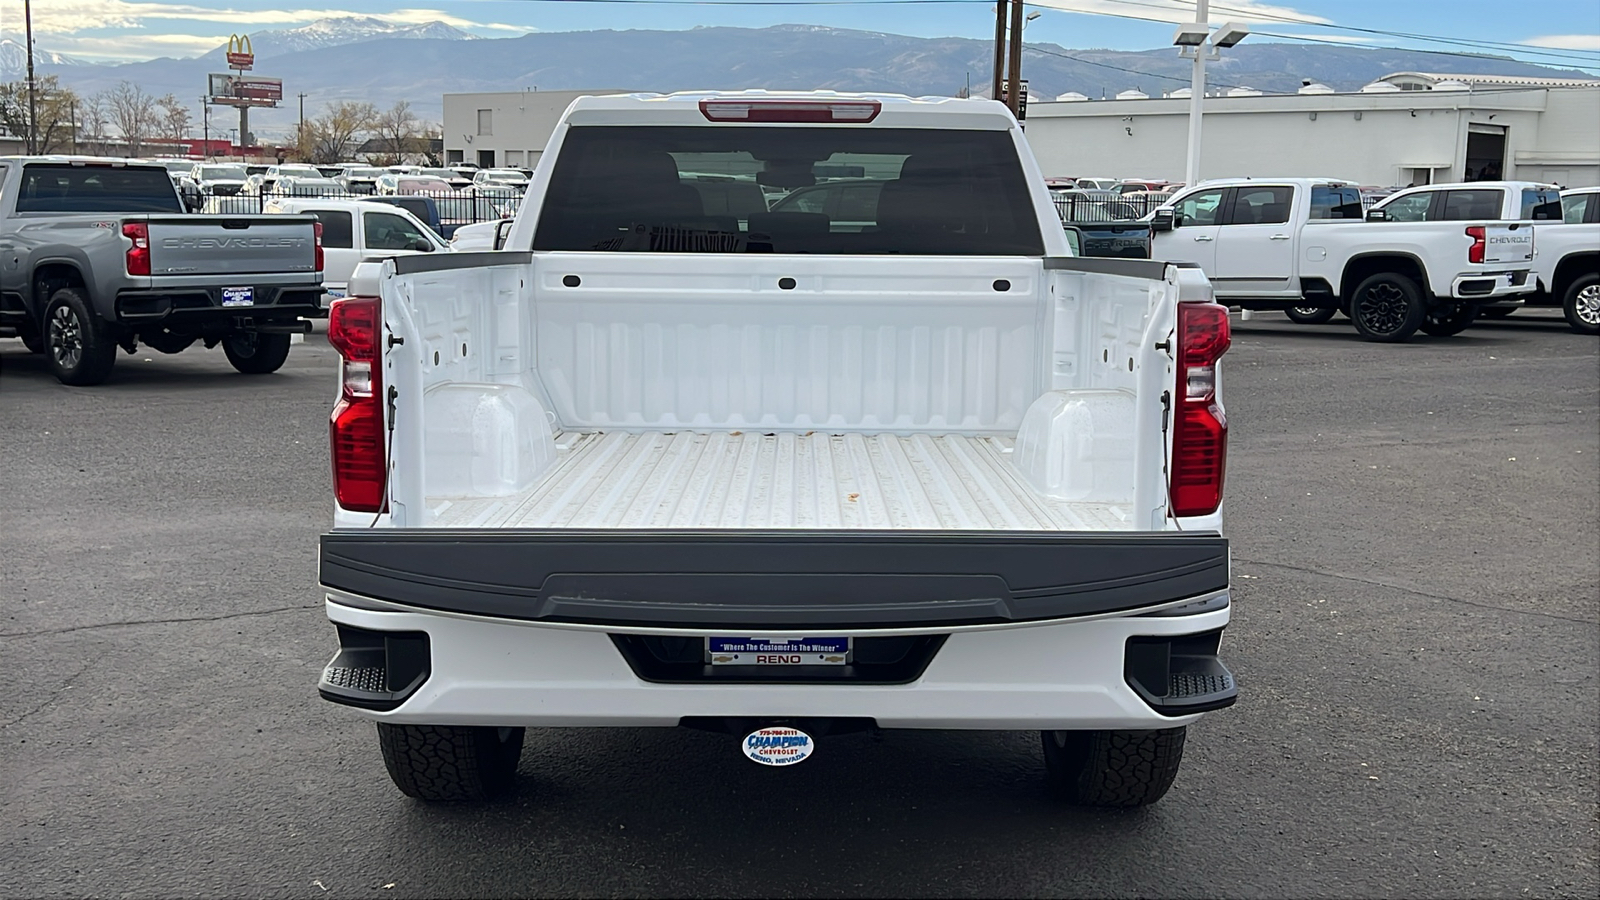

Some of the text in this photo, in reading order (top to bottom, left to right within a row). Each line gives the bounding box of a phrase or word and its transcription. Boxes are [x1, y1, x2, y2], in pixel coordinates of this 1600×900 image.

[162, 237, 305, 249] CHEVROLET
[746, 643, 758, 651] The
[759, 643, 790, 651] Customer
[791, 643, 798, 651] Is
[799, 643, 811, 651] The
[757, 655, 801, 664] RENO
[748, 735, 808, 749] CHAMPION
[775, 752, 807, 764] NEVADA
